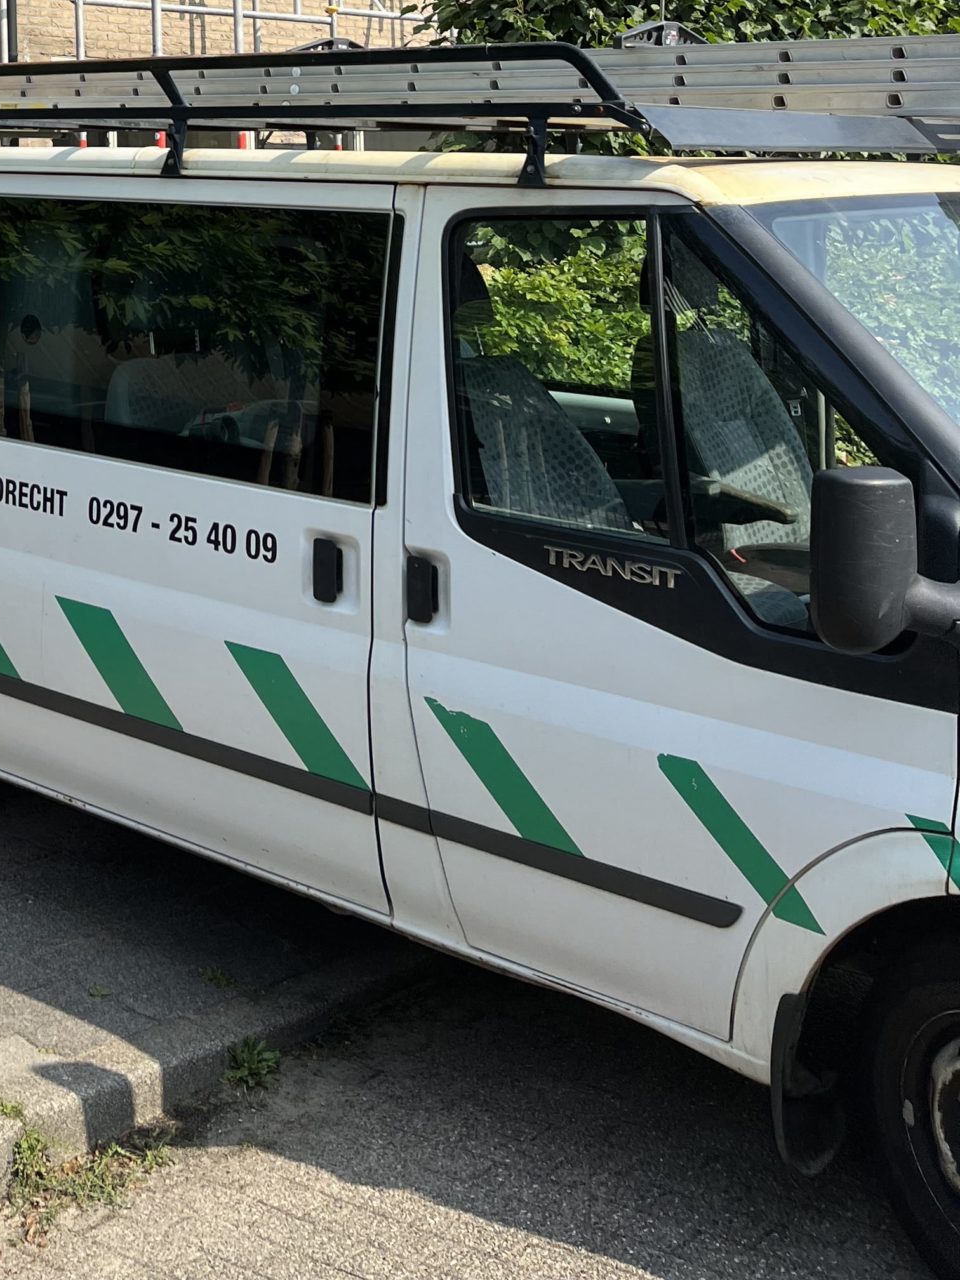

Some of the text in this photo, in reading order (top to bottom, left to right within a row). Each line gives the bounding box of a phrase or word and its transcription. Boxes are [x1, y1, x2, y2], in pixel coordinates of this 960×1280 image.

[87, 496, 143, 533] 0297
[168, 513, 198, 546] 25
[206, 522, 237, 554] 40
[245, 529, 278, 563] 09
[543, 545, 682, 589] TRANSIT
